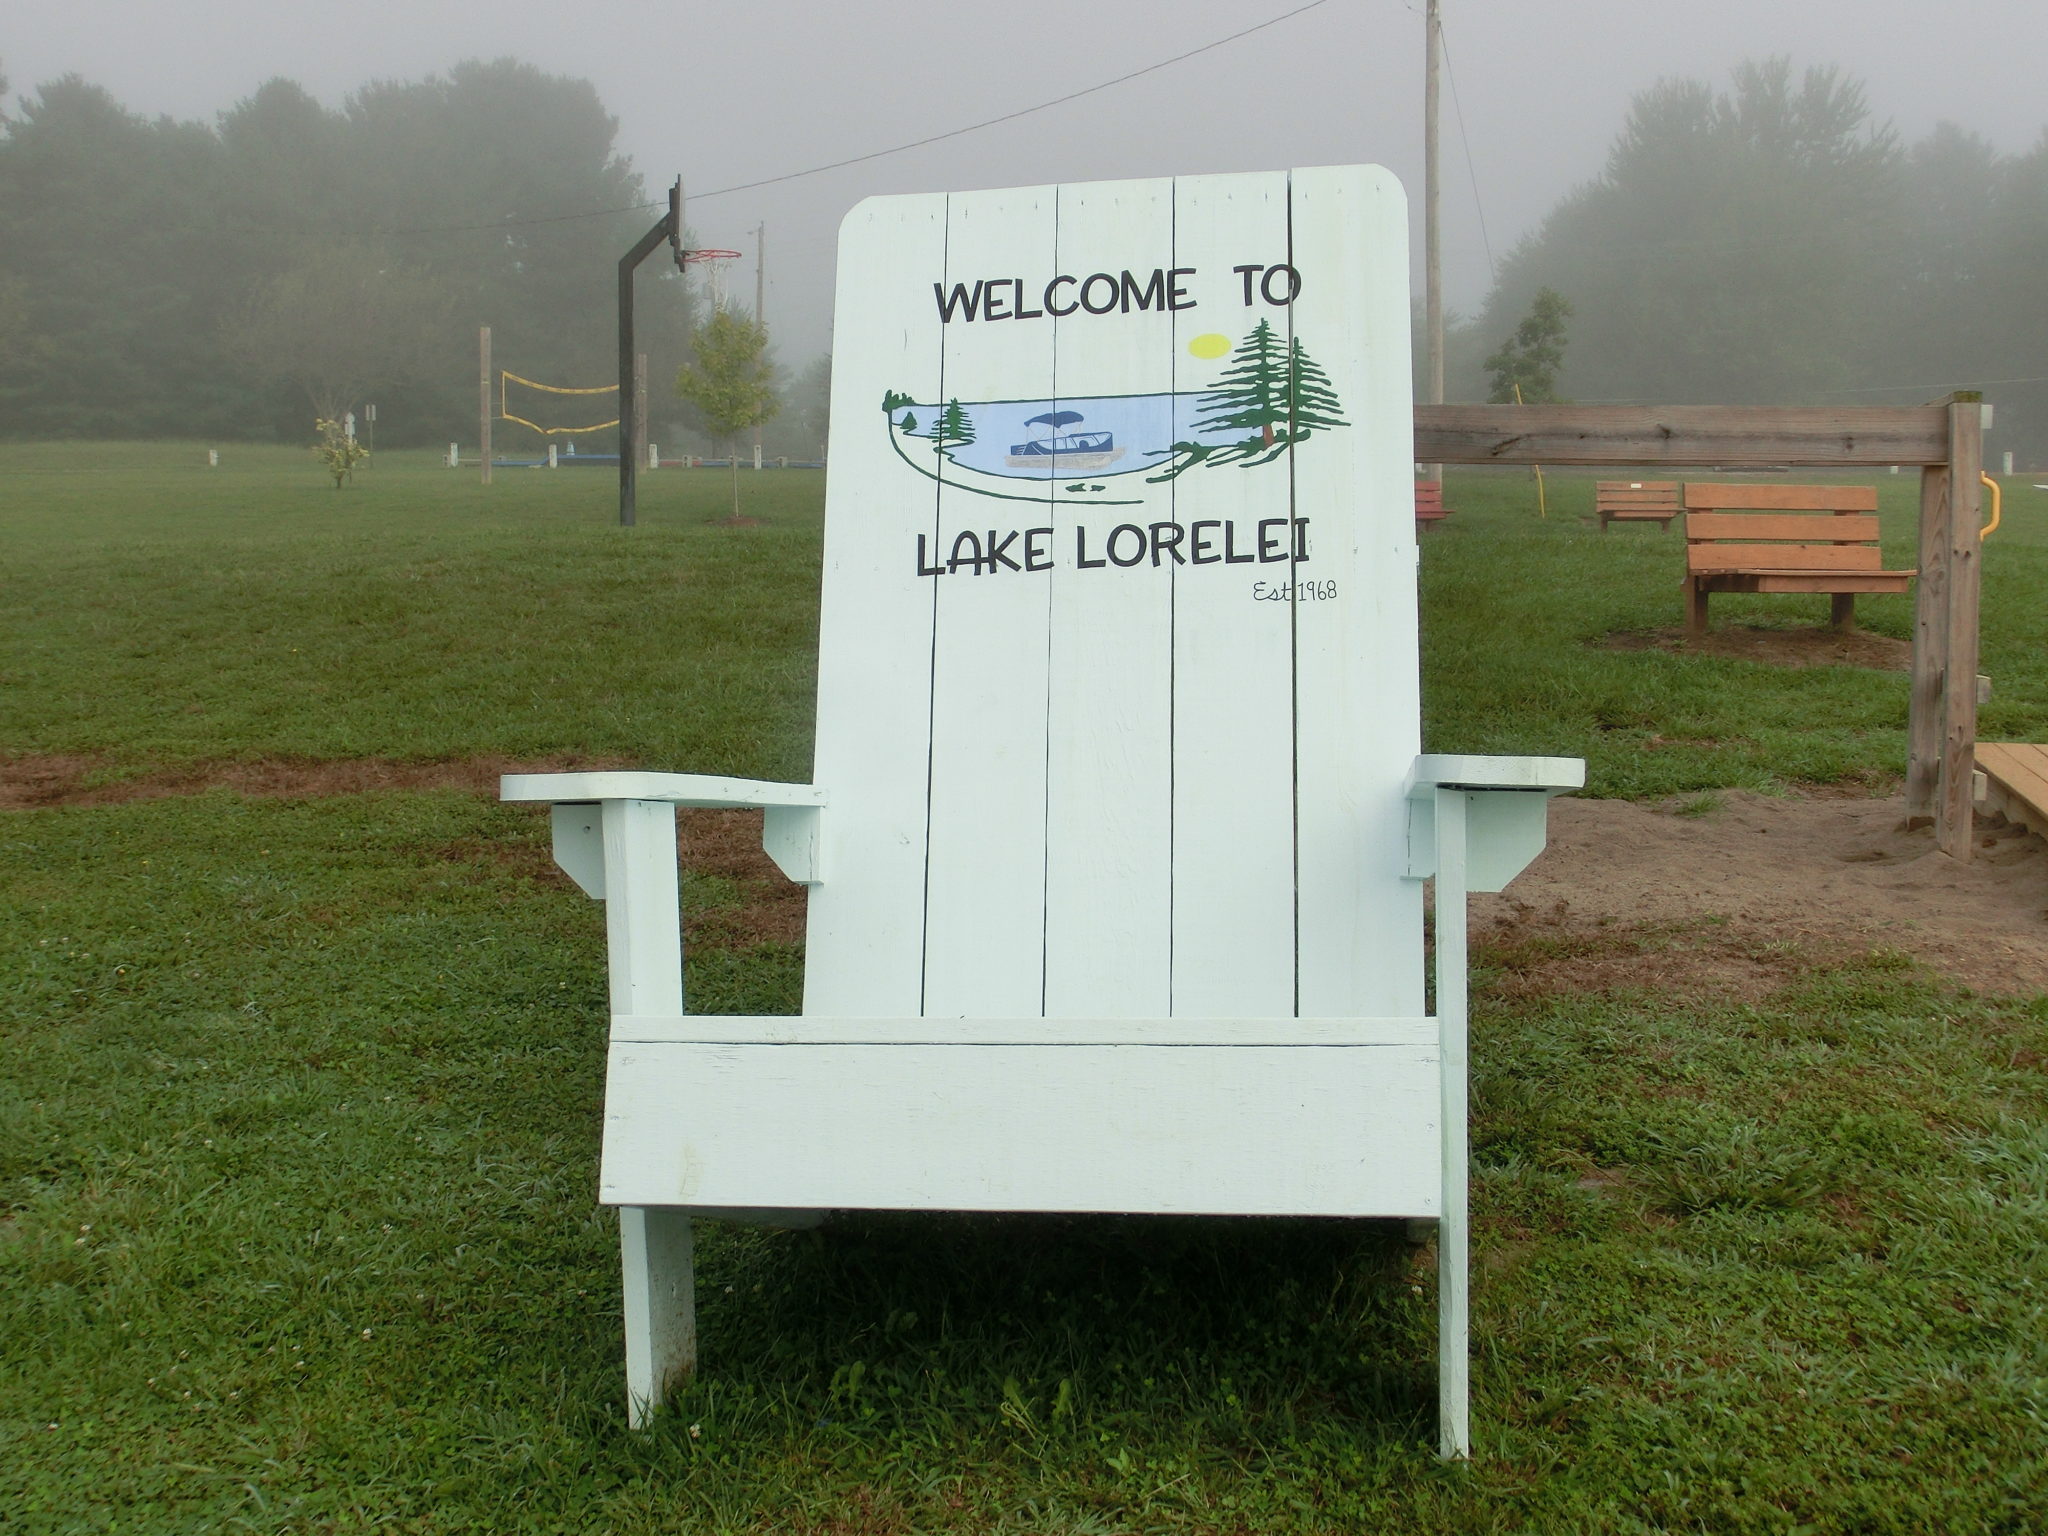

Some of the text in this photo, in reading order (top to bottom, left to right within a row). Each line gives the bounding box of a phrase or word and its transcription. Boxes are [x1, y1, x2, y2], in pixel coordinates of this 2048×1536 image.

[934, 264, 1302, 324] WELCOME TO
[916, 517, 1311, 577] LAKE LORELEI
[1297, 579, 1337, 602] 1968
